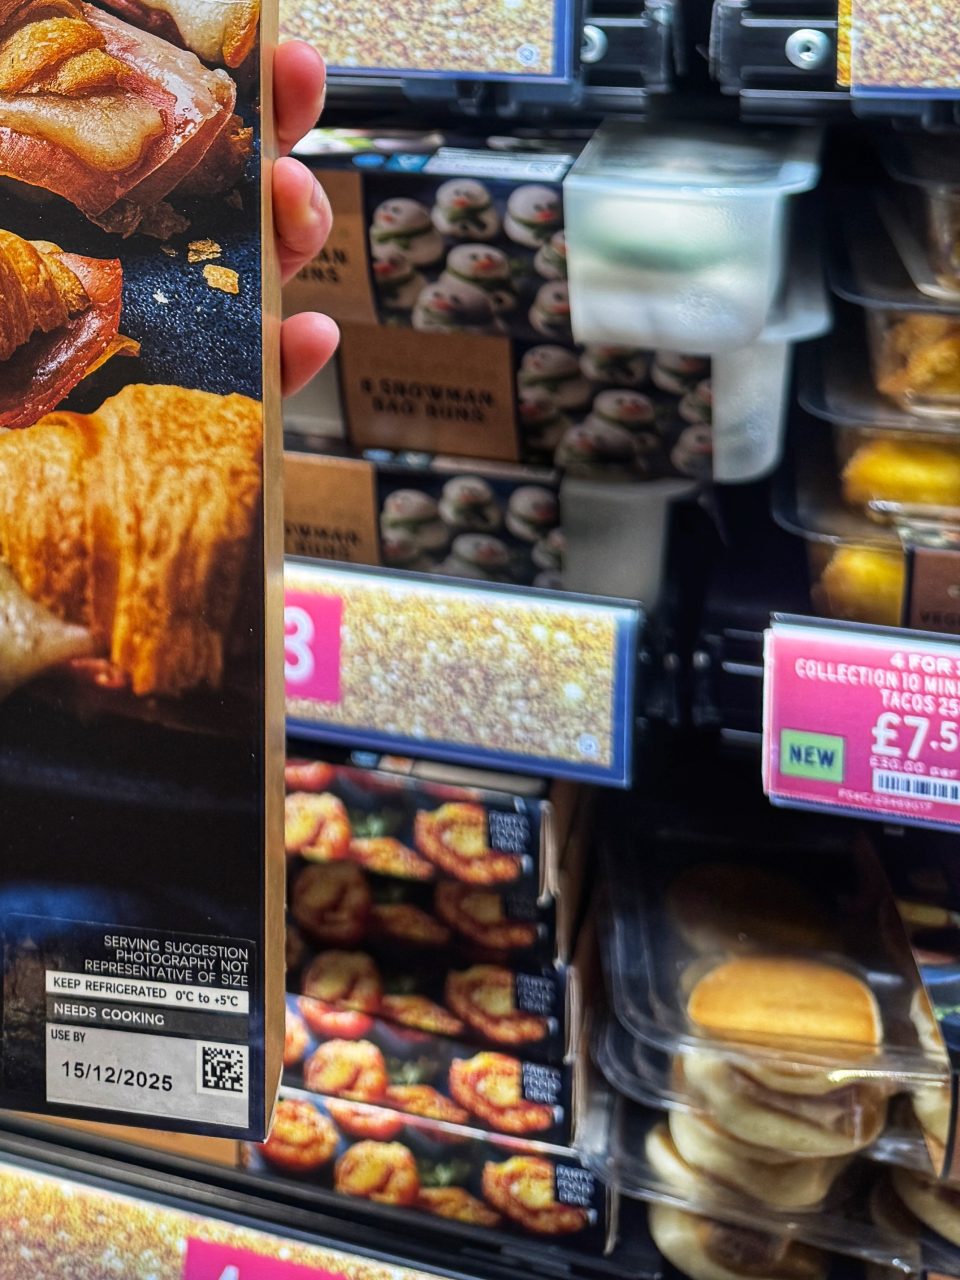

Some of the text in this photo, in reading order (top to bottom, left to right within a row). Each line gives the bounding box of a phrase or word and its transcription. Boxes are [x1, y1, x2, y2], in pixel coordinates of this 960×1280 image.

[284, 606, 315, 685] 3
[795, 657, 900, 689] COLLECTION
[902, 672, 922, 692] 10
[890, 652, 953, 675] 4 FOR
[880, 688, 936, 715] TACOS
[789, 745, 835, 767] NEW
[104, 935, 248, 960] SERVING SUGGESTION
[84, 959, 248, 987] REPRESENTATIVE OF SIZE
[116, 949, 248, 973] PHOTOGRAPHY NOT
[53, 976, 239, 1007] KEEP REFRIGERATED 0°C to +5°C
[54, 1002, 165, 1025] NEEDS COOKING
[51, 1028, 86, 1043] USE BY
[62, 1060, 173, 1092] 15/12/2025
